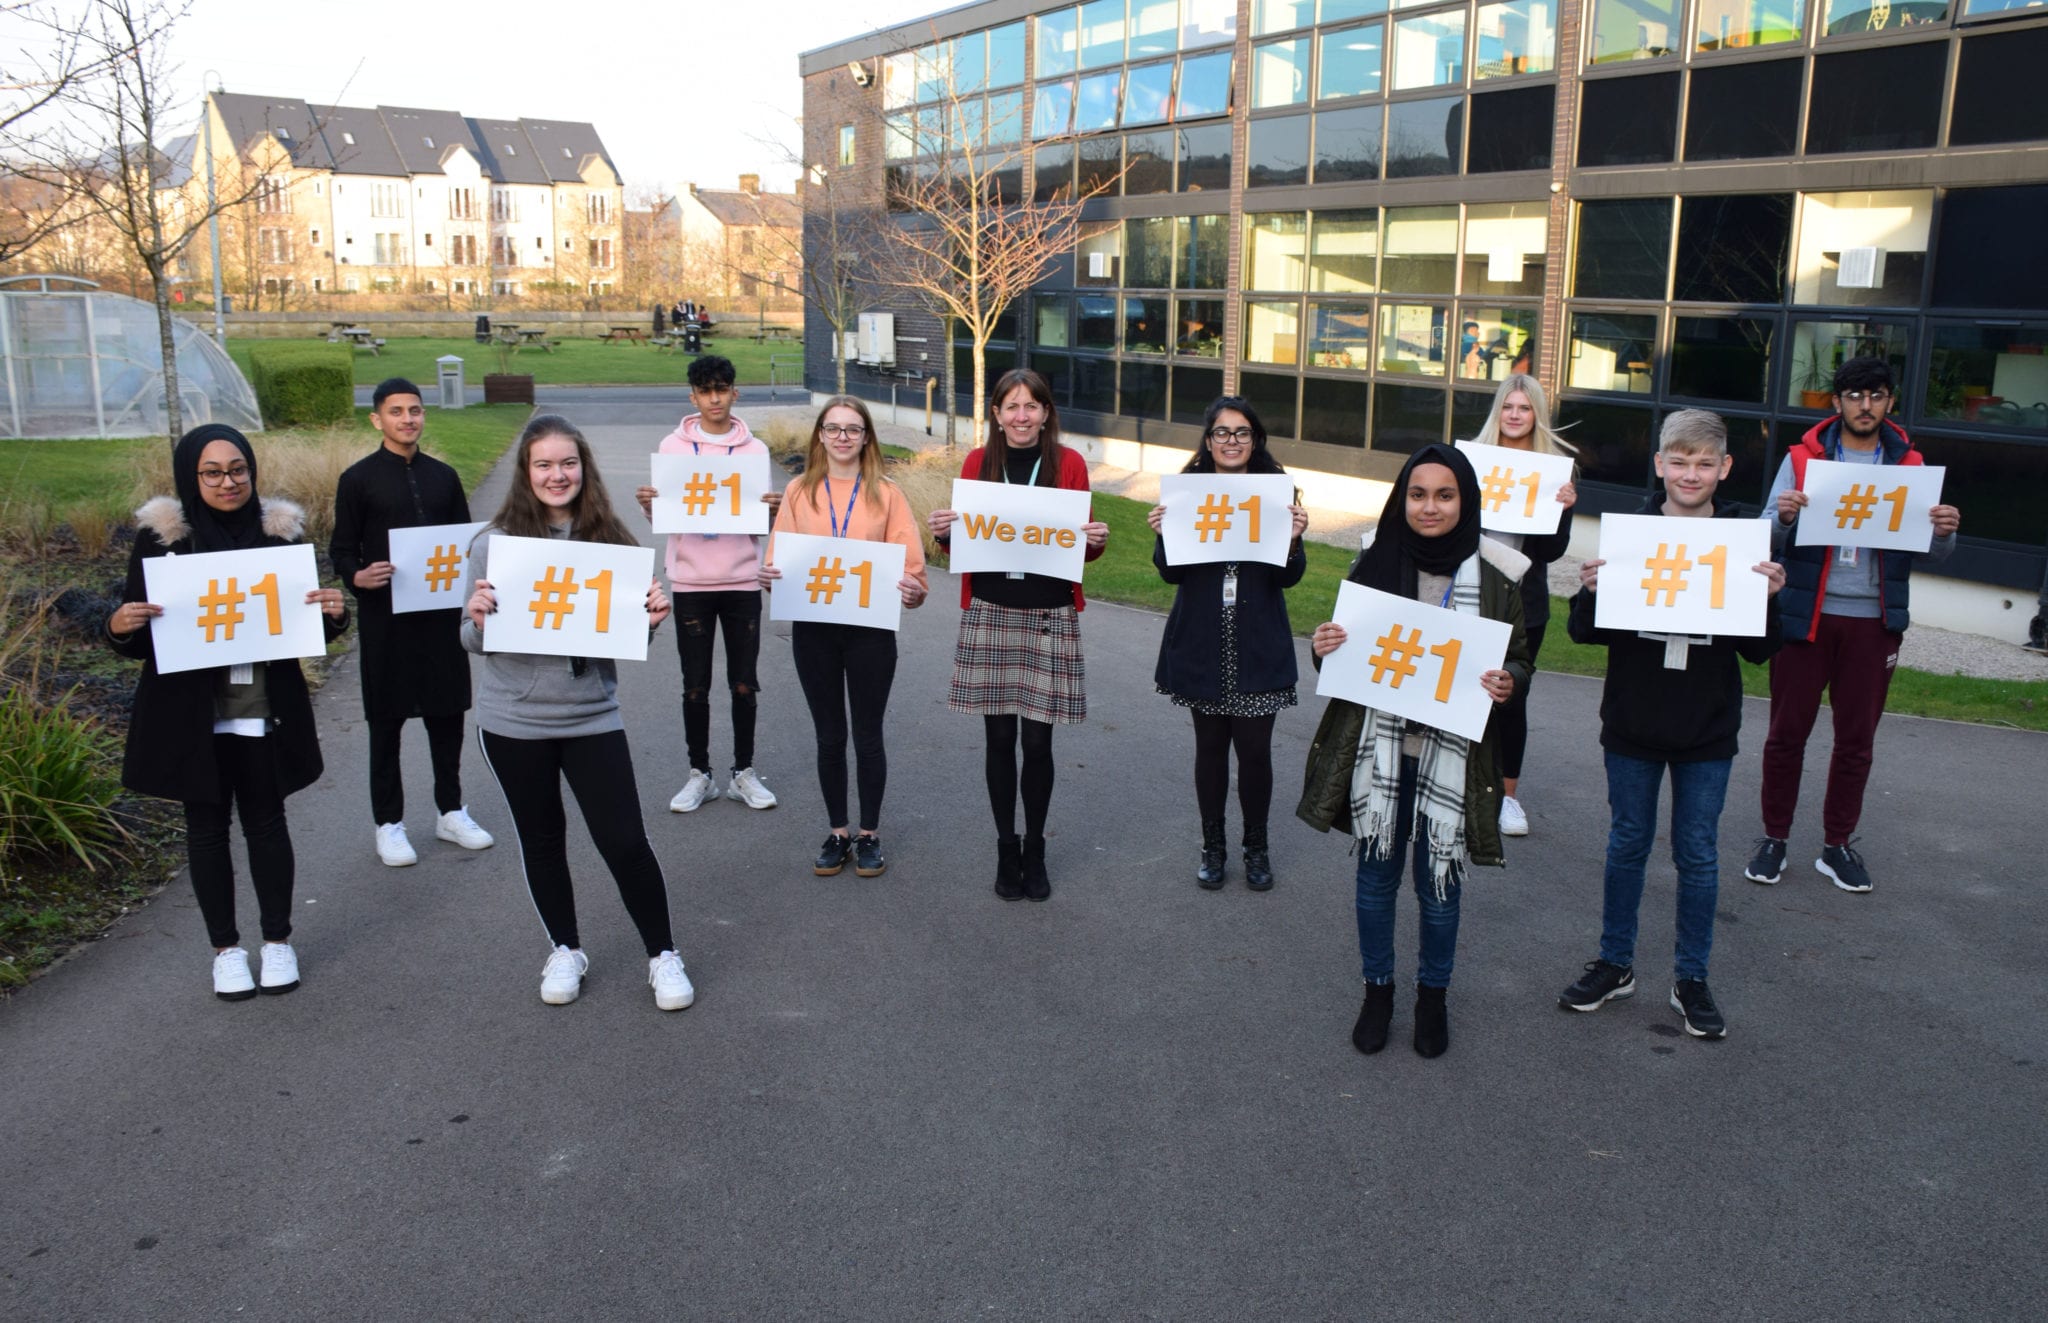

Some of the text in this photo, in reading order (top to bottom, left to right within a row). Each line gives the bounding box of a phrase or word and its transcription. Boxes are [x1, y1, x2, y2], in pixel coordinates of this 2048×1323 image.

[683, 472, 741, 516] #1
[1481, 465, 1541, 518] #1
[1835, 484, 1908, 532] #1
[963, 513, 1076, 548] We are
[1194, 494, 1261, 543] #1
[529, 566, 613, 633] #1
[806, 556, 872, 608] #1
[1641, 543, 1727, 608] #1
[197, 573, 282, 643] #1
[1368, 623, 1462, 703] #1
